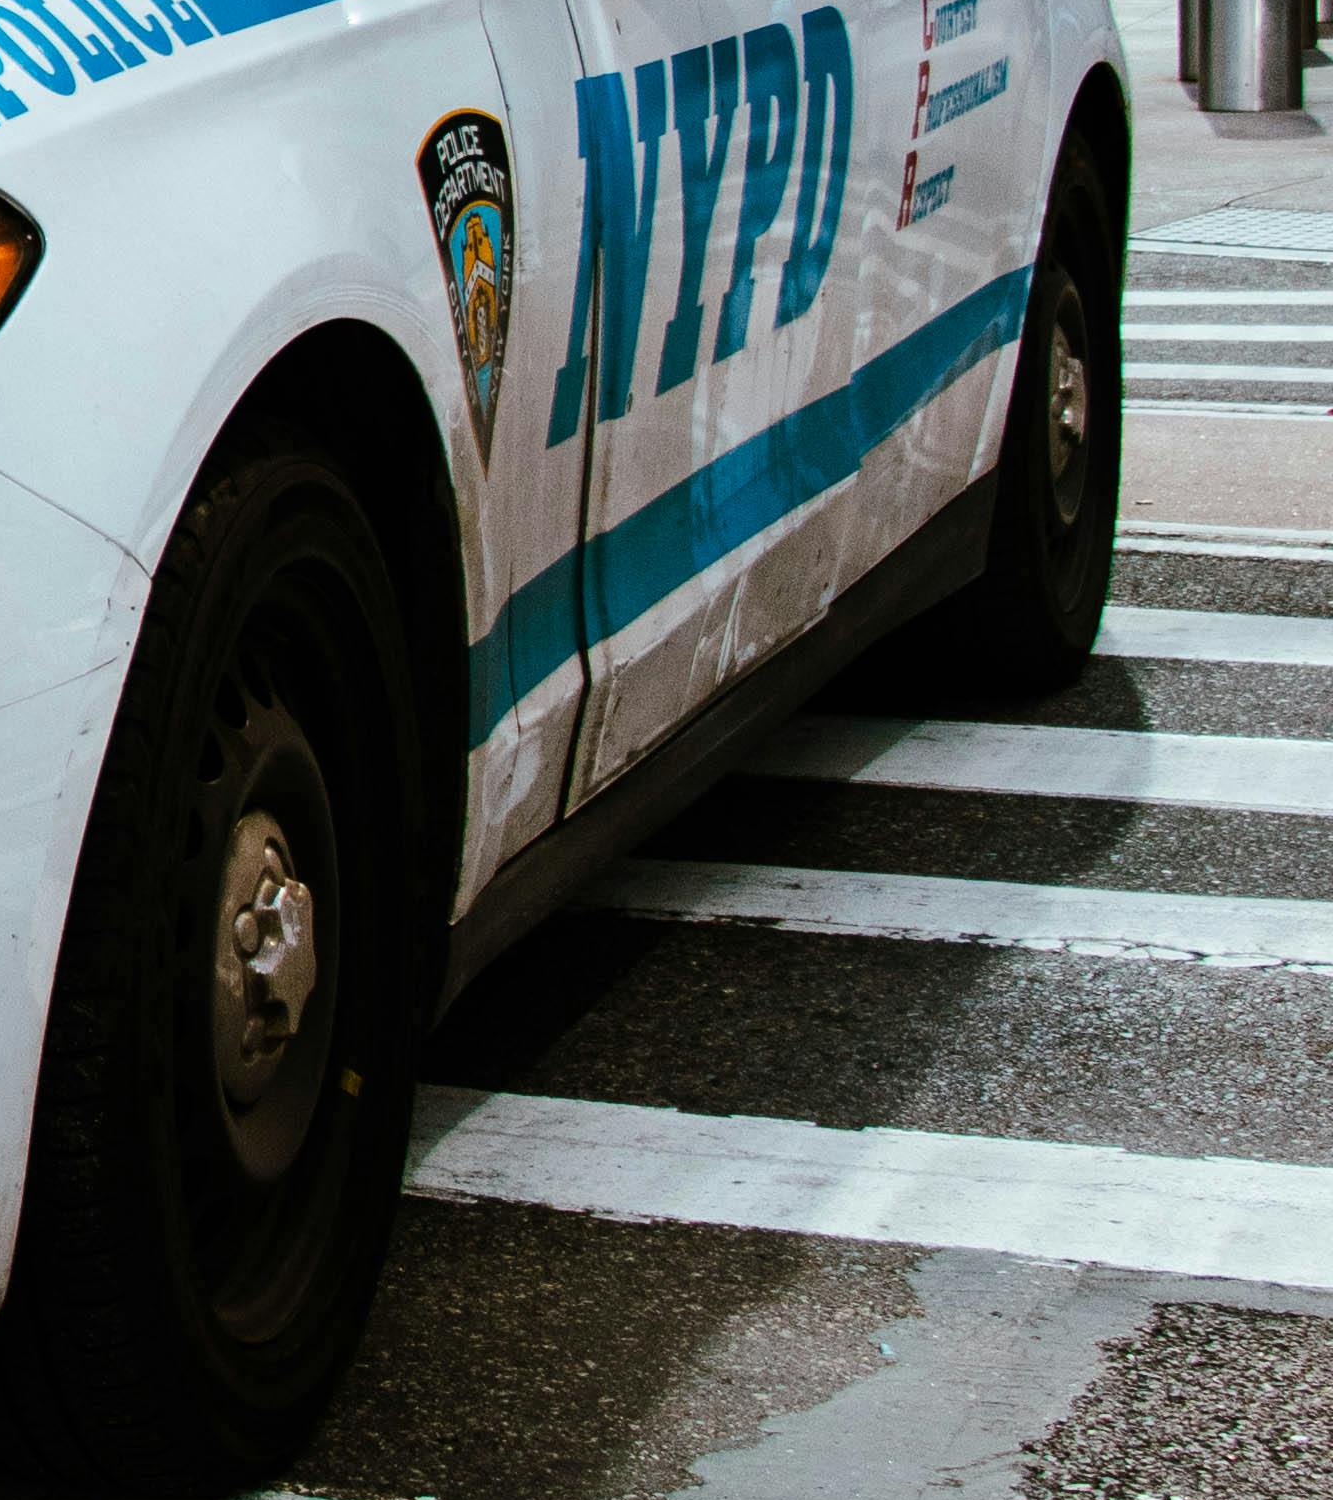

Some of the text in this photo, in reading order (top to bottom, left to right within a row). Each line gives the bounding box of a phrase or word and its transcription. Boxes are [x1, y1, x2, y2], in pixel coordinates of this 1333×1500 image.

[436, 124, 484, 174] POLICE
[433, 160, 507, 241] DEPARTMENT
[545, 4, 854, 450] NYPD
[498, 231, 512, 314] YORK
